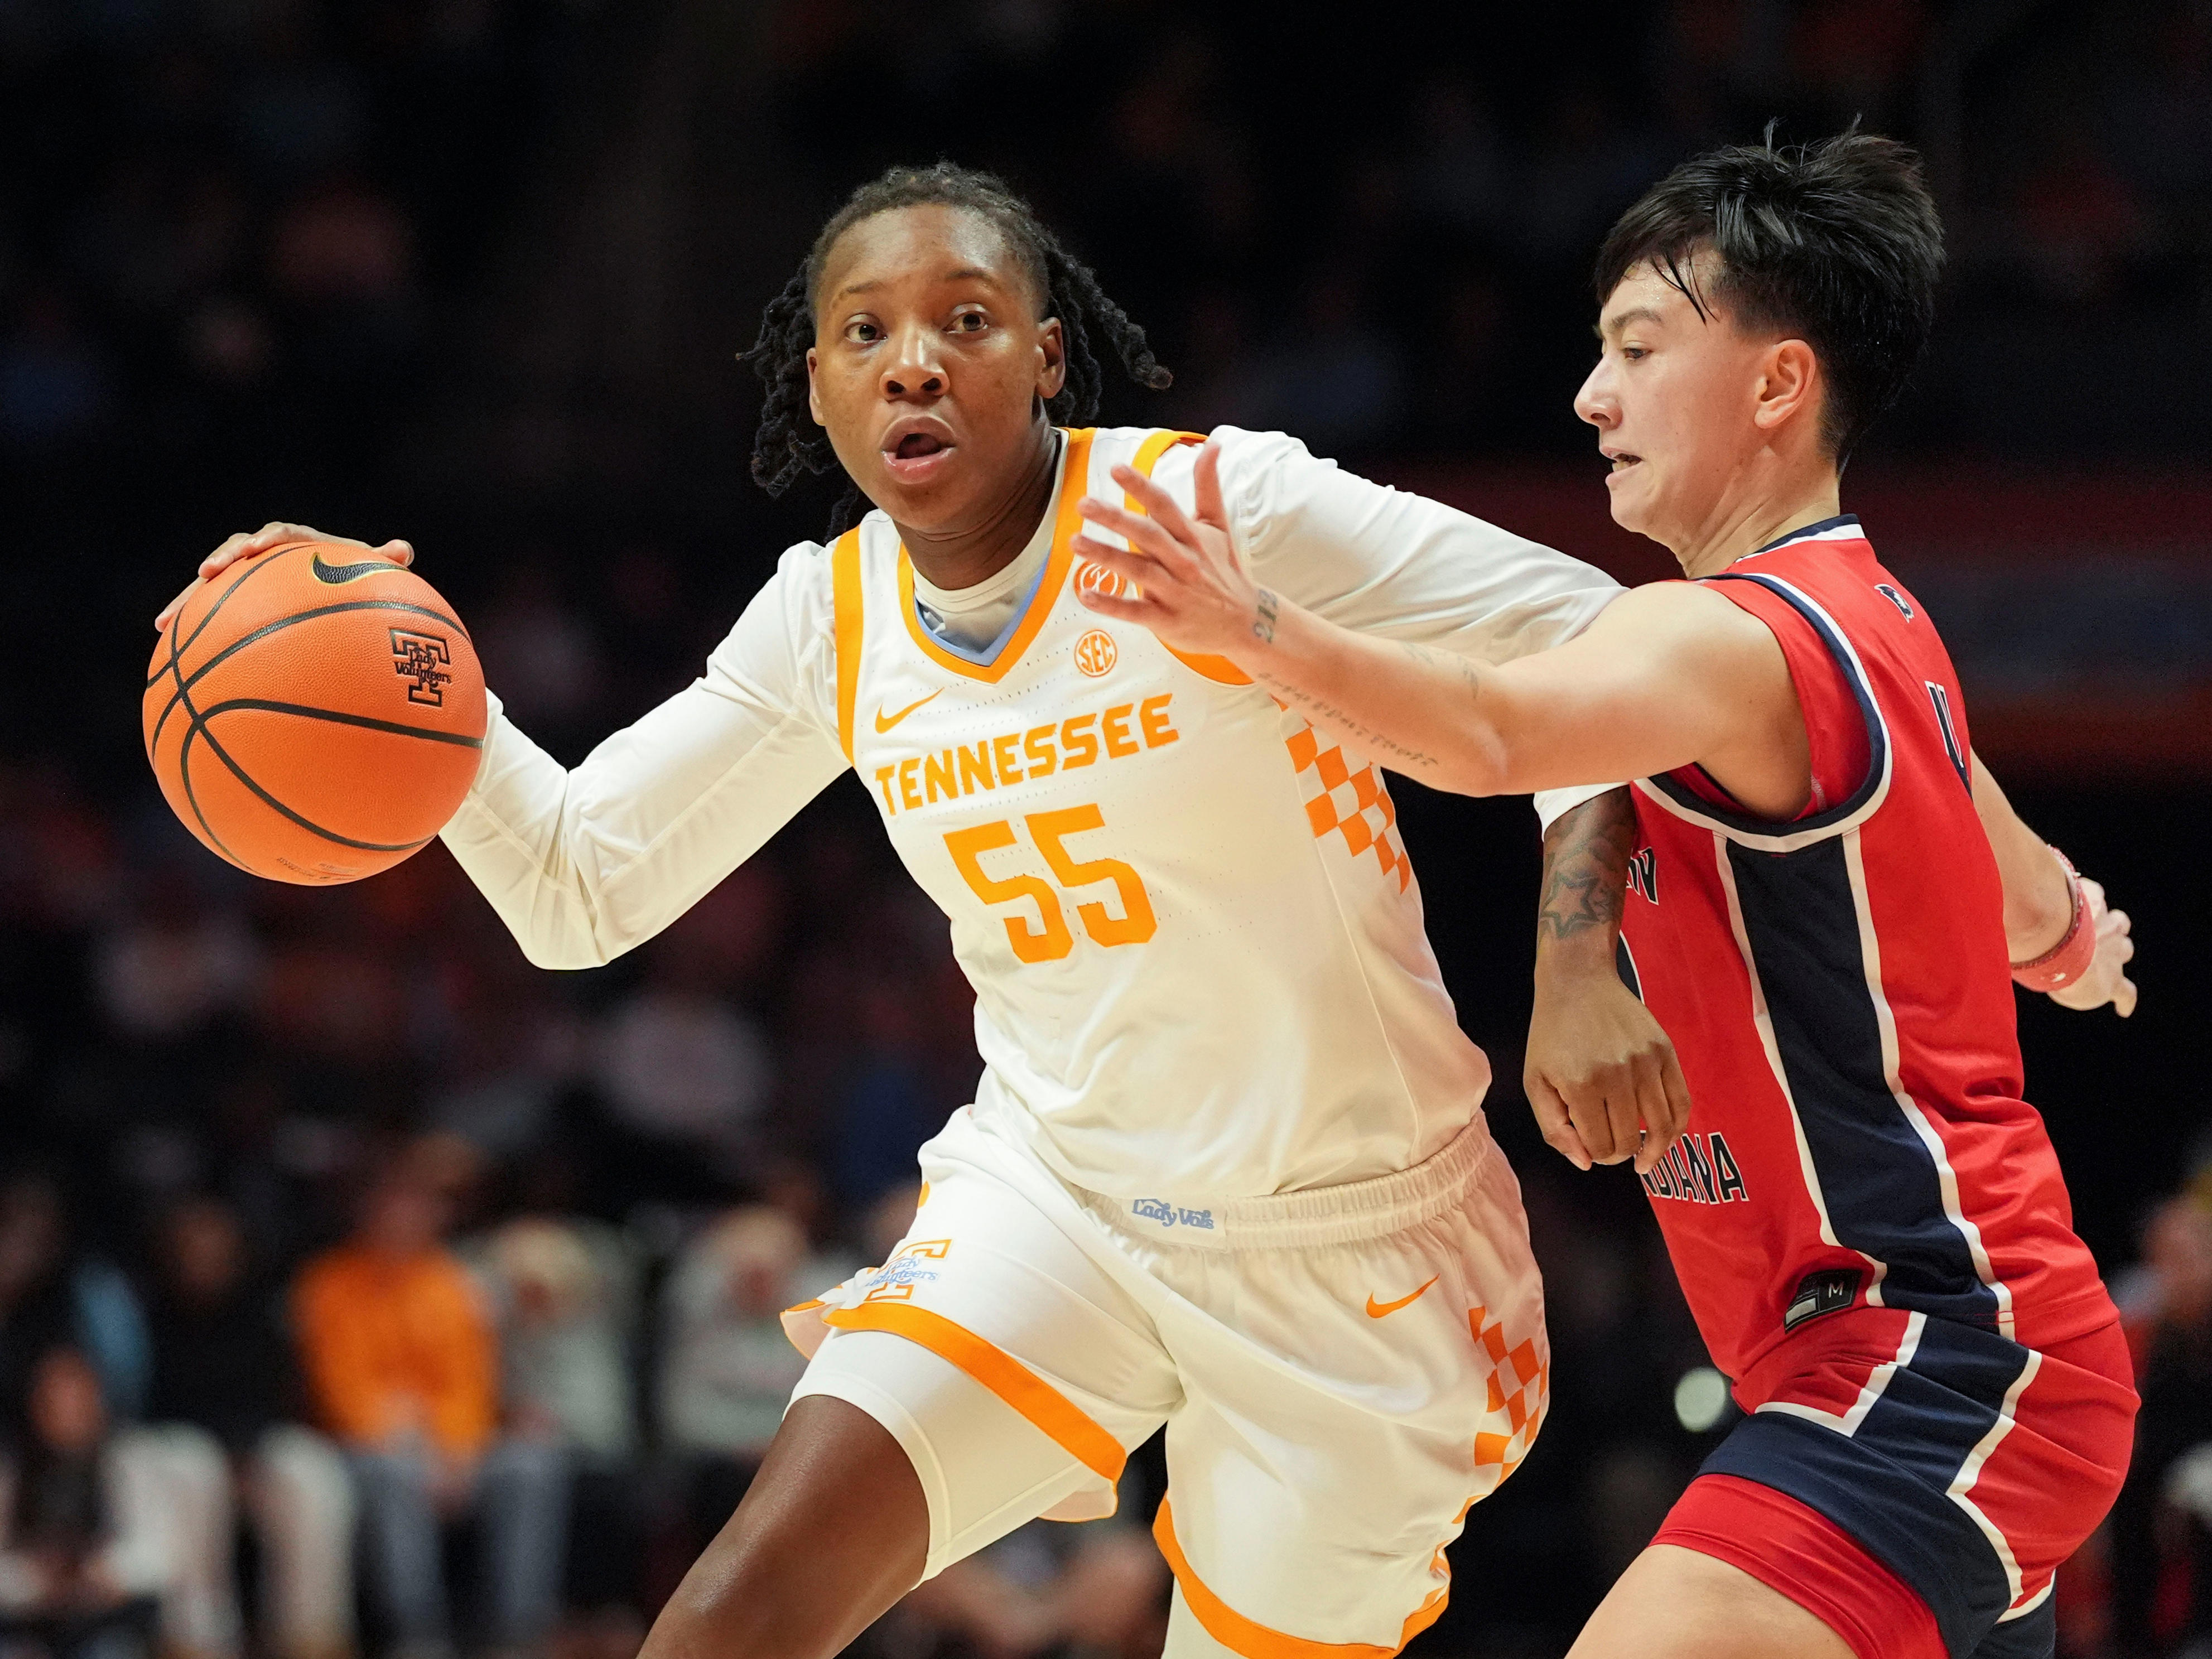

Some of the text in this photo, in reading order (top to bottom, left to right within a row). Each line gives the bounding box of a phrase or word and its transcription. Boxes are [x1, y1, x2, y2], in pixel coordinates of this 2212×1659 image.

[1078, 634, 1114, 673] SEC
[394, 662, 451, 684] Volunteers
[875, 693, 1179, 816] TENNESSEE
[942, 802, 1158, 964] 55
[1132, 1198, 1215, 1229] Lady Vols
[1828, 1282, 1844, 1299] M
